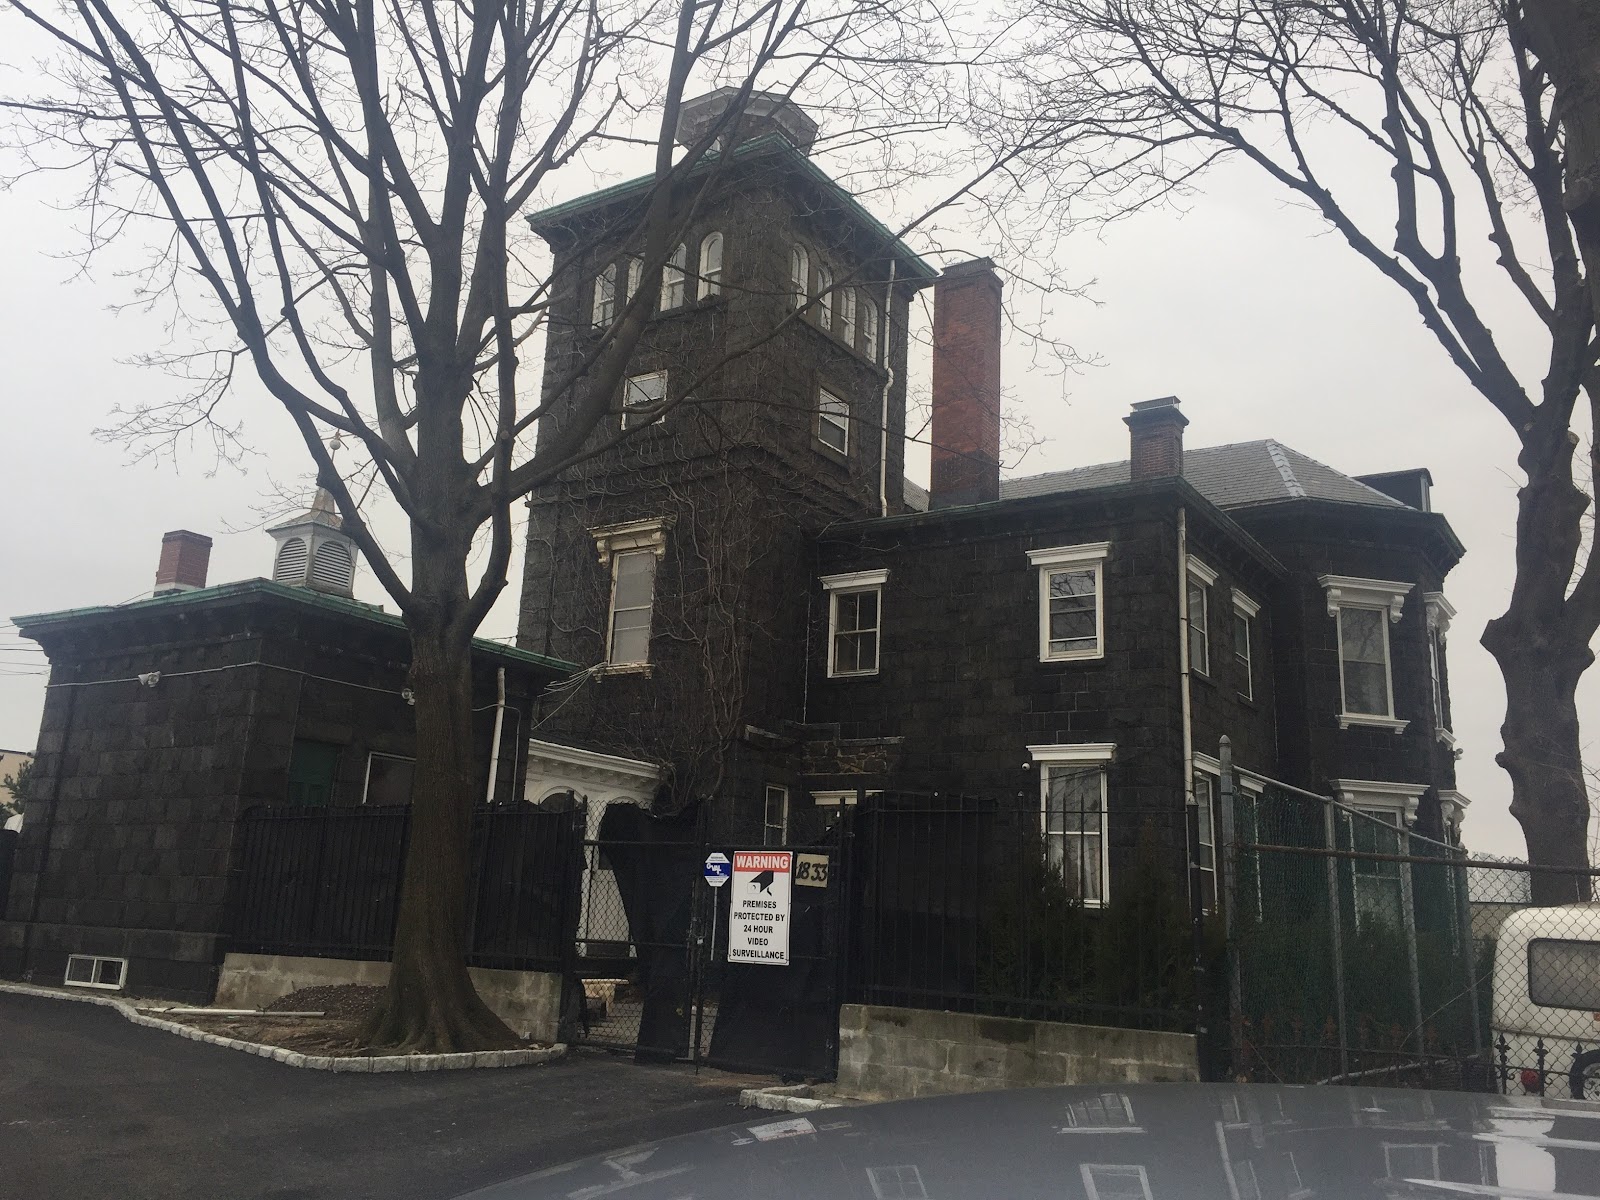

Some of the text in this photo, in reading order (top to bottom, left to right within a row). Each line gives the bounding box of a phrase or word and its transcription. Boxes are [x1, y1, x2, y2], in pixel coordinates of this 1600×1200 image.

[736, 855, 789, 869] WARNING
[742, 900, 777, 909] PREMISES
[733, 912, 785, 922] PROTECTED BY
[743, 924, 773, 934] 24 HOUR
[747, 937, 769, 946] VIDEO
[732, 949, 785, 960] SURVEILLANCE
